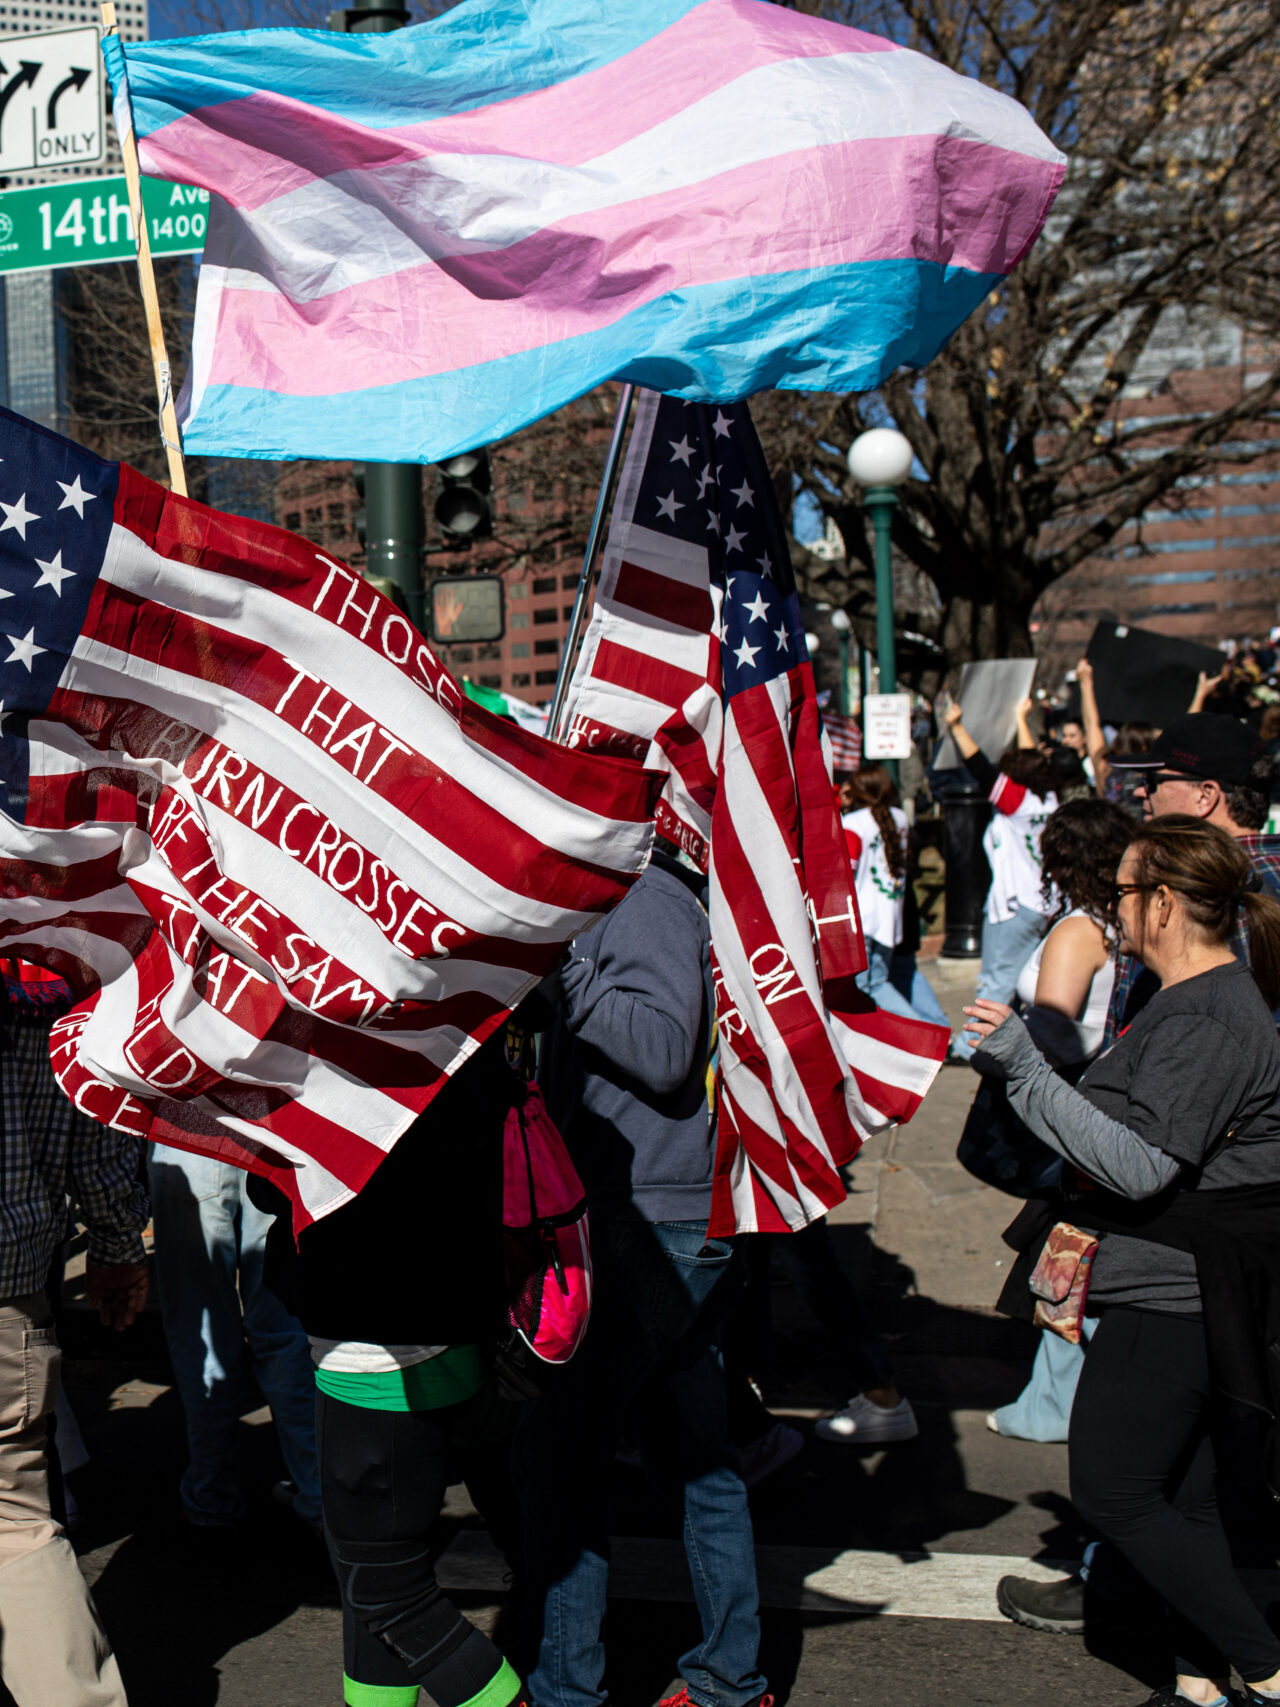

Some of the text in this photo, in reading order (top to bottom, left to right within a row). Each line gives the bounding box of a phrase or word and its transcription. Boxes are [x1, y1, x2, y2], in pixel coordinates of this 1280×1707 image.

[39, 131, 97, 158] ONLY
[39, 184, 210, 251] 14th Ave
[152, 213, 206, 240] 1400
[314, 553, 462, 725] THOSE
[272, 656, 416, 785] THAT
[182, 835, 280, 950] THE
[270, 932, 405, 1031] SAME
[279, 802, 467, 961] CROSSES
[749, 943, 808, 1006] ON
[48, 1011, 148, 1138] OFFICE
[125, 979, 198, 1089] HLD
